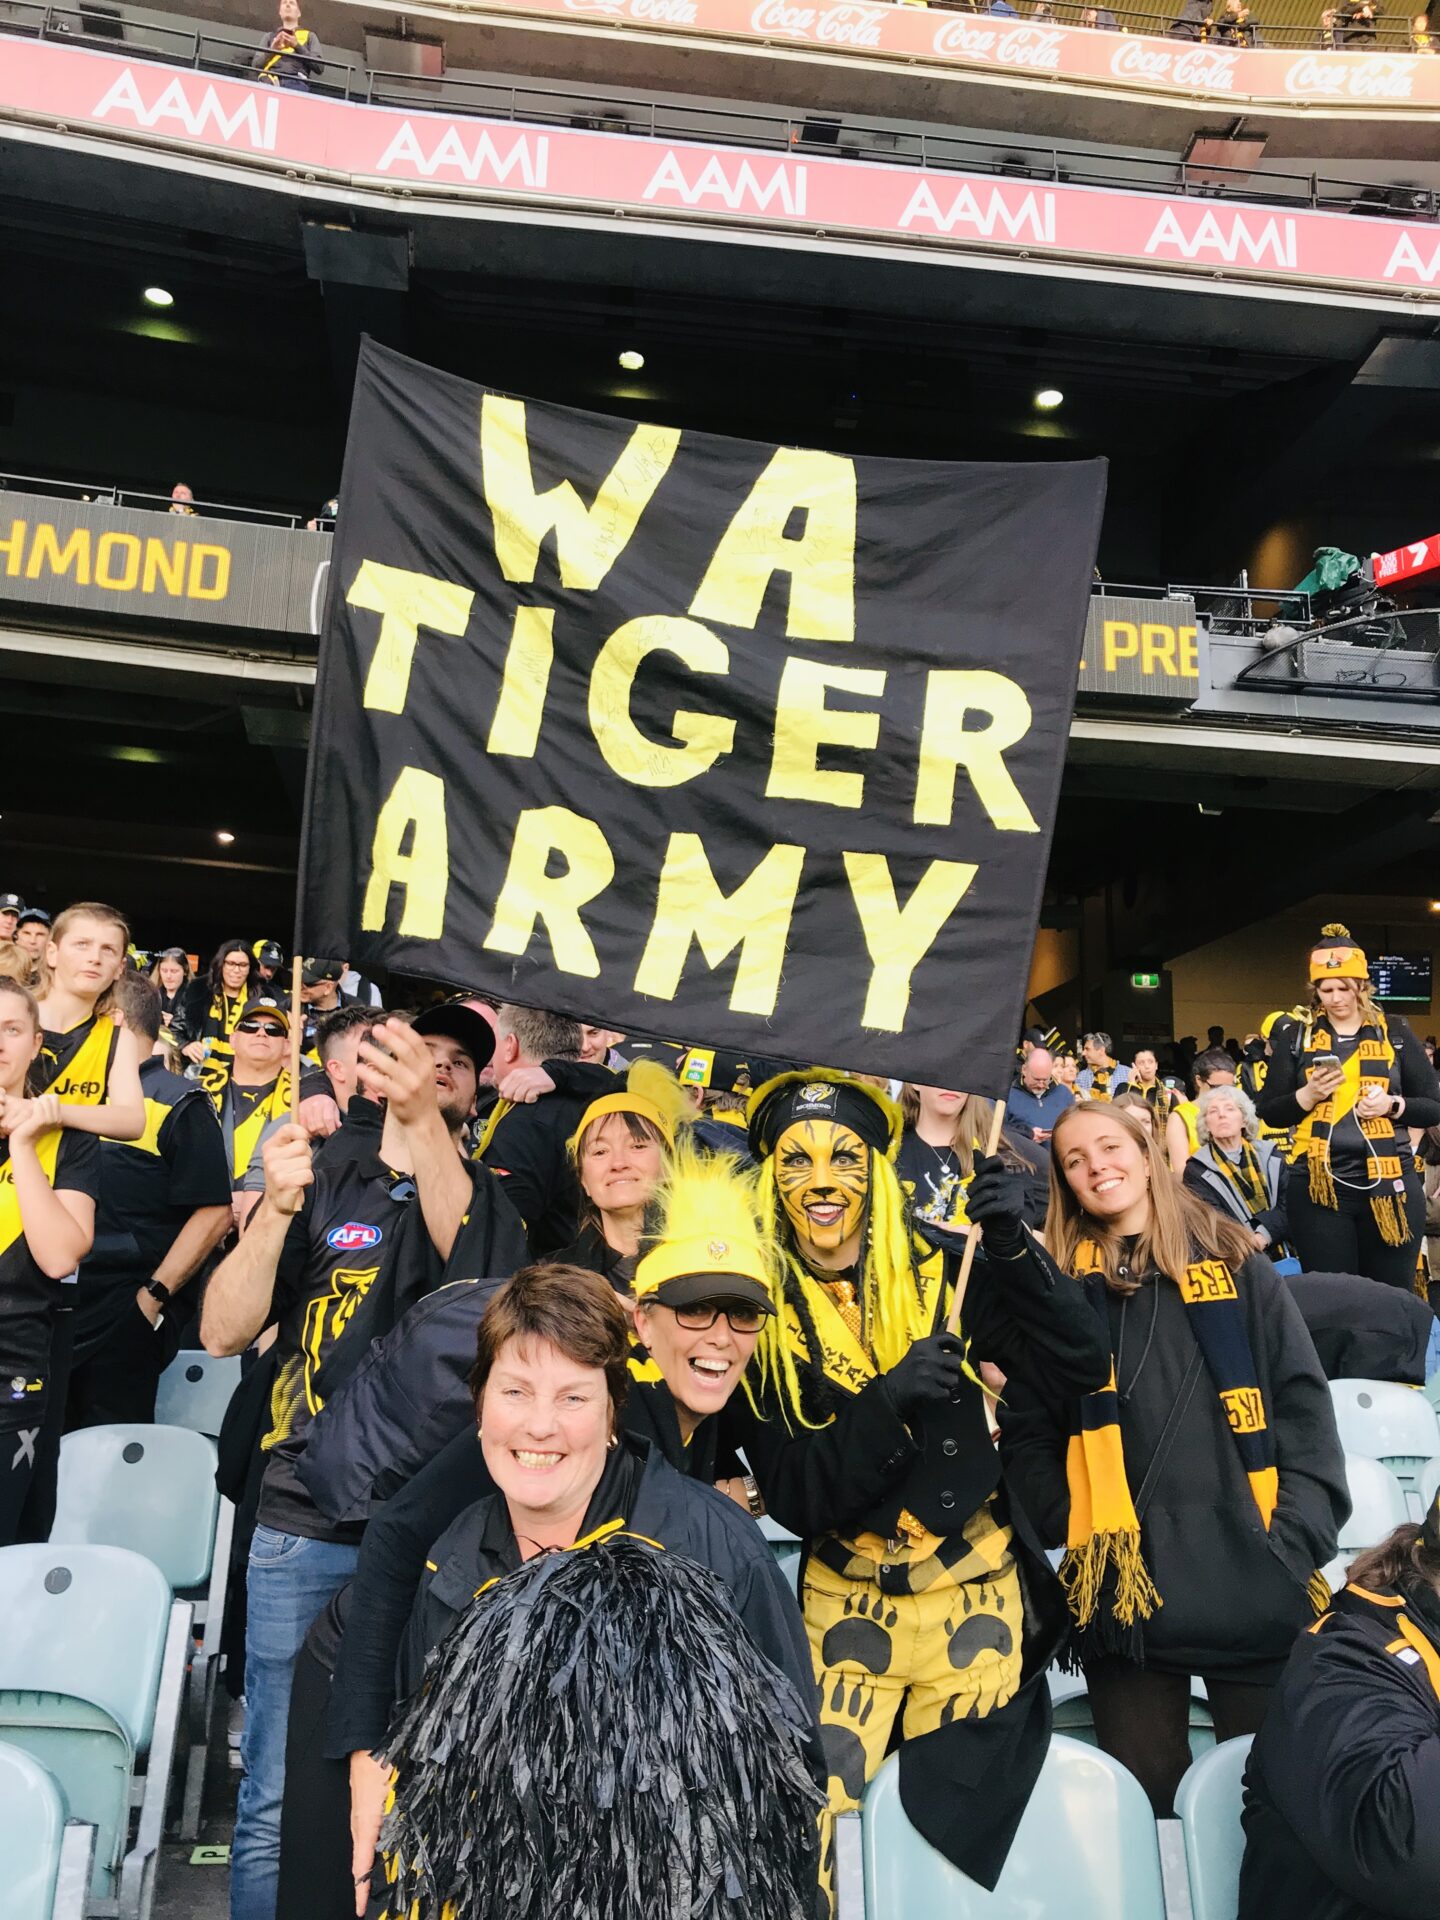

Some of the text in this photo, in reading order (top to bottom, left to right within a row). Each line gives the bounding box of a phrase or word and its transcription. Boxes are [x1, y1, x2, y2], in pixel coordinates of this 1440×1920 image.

[91, 68, 279, 150] AAMI
[375, 120, 549, 188] AAMI
[641, 150, 807, 216] AAMI
[898, 179, 1056, 243] AAMI
[1144, 206, 1297, 268] AAMI
[1407, 541, 1429, 568] 7
[346, 559, 1040, 833] TIGER
[362, 767, 979, 1033] ARMY
[54, 1078, 101, 1098] Jeep
[329, 1228, 376, 1244] AFL
